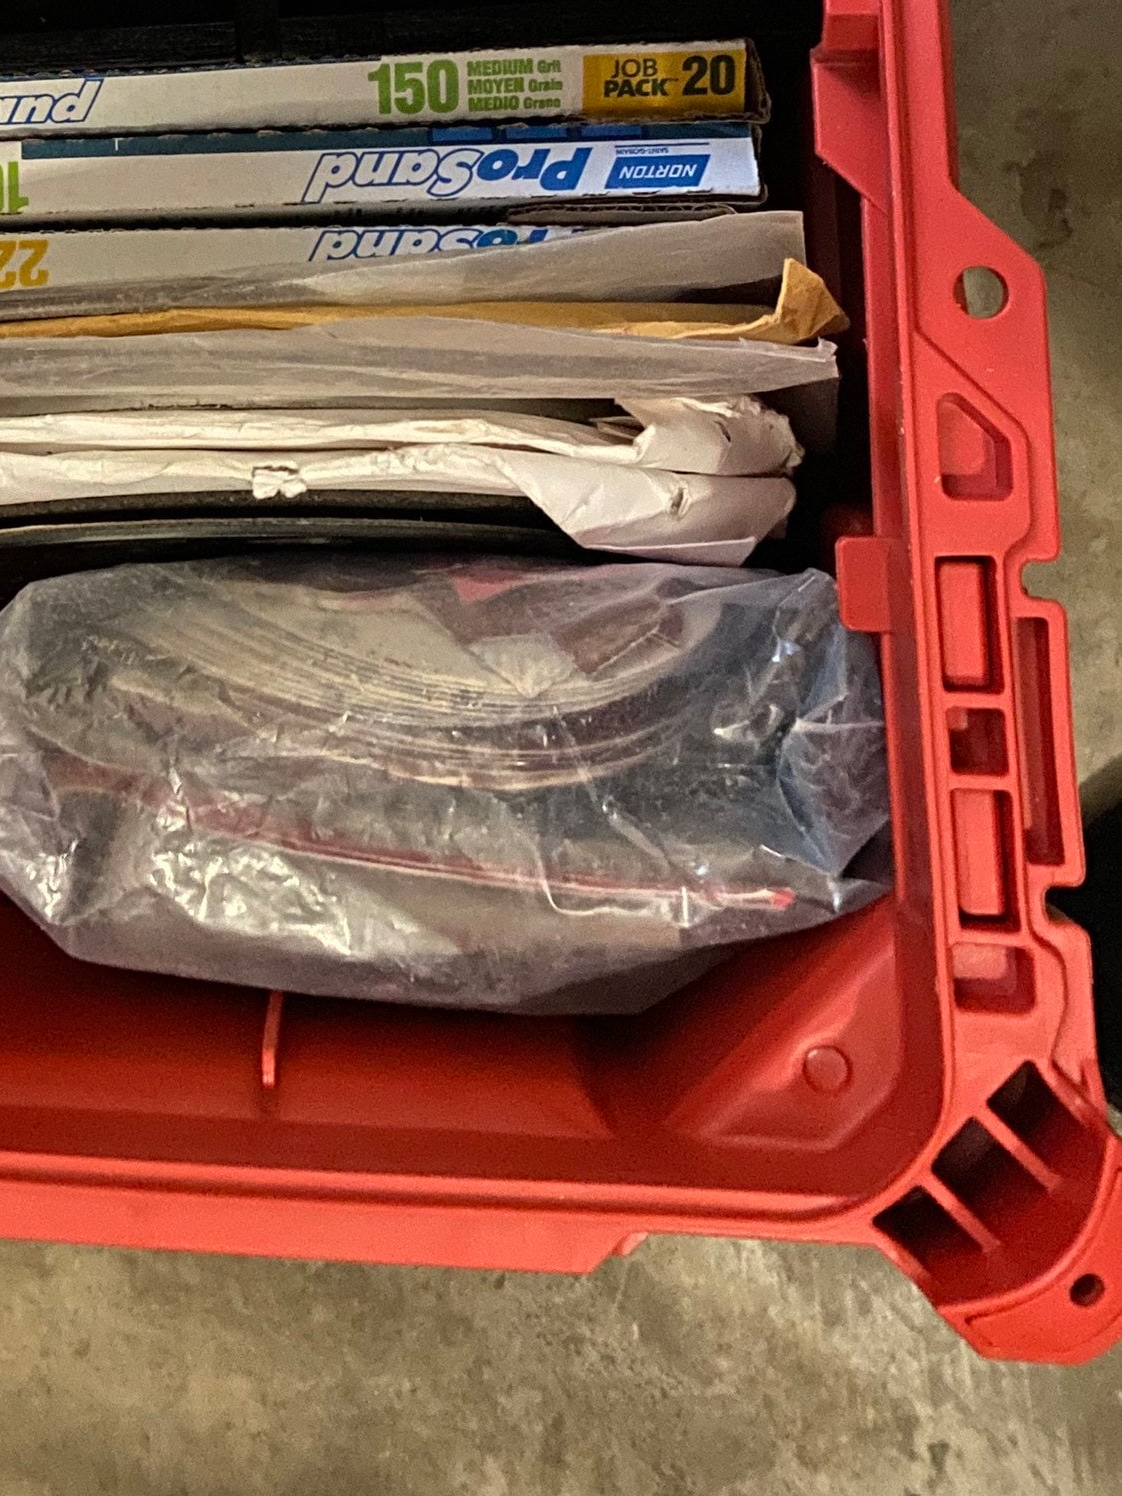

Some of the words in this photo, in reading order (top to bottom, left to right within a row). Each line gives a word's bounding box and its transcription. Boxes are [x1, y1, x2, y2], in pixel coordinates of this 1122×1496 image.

[611, 58, 658, 79] JOB
[681, 55, 736, 96] 20
[367, 58, 459, 115] 150
[468, 58, 533, 76] MEDIUM
[537, 58, 562, 74] Grit
[468, 77, 525, 94] MOYEN
[528, 77, 564, 92] Grain
[468, 94, 519, 112] MEDIO
[302, 147, 594, 204] ProSand
[619, 163, 697, 180] NORTON
[308, 228, 585, 262] roSand
